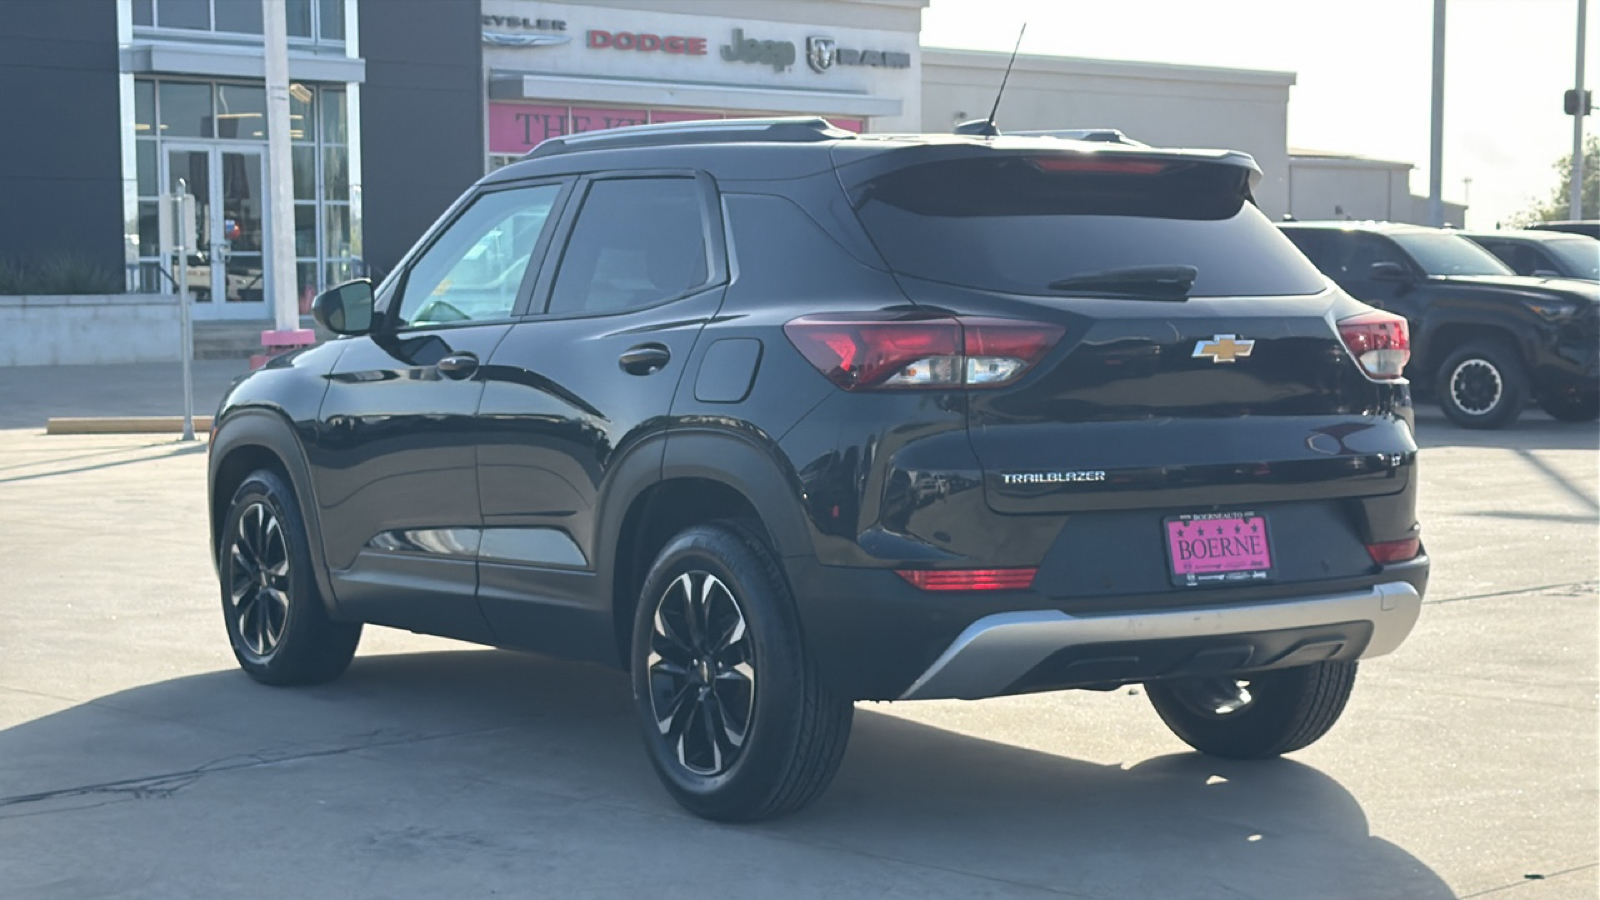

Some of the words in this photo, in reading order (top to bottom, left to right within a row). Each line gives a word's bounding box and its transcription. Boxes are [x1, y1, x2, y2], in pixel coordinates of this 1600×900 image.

[586, 30, 707, 55] DODGE
[720, 28, 796, 73] Jeep
[836, 48, 911, 69] RAM
[1001, 470, 1106, 484] TRAILBLAZER
[1178, 535, 1263, 560] BOERNE
